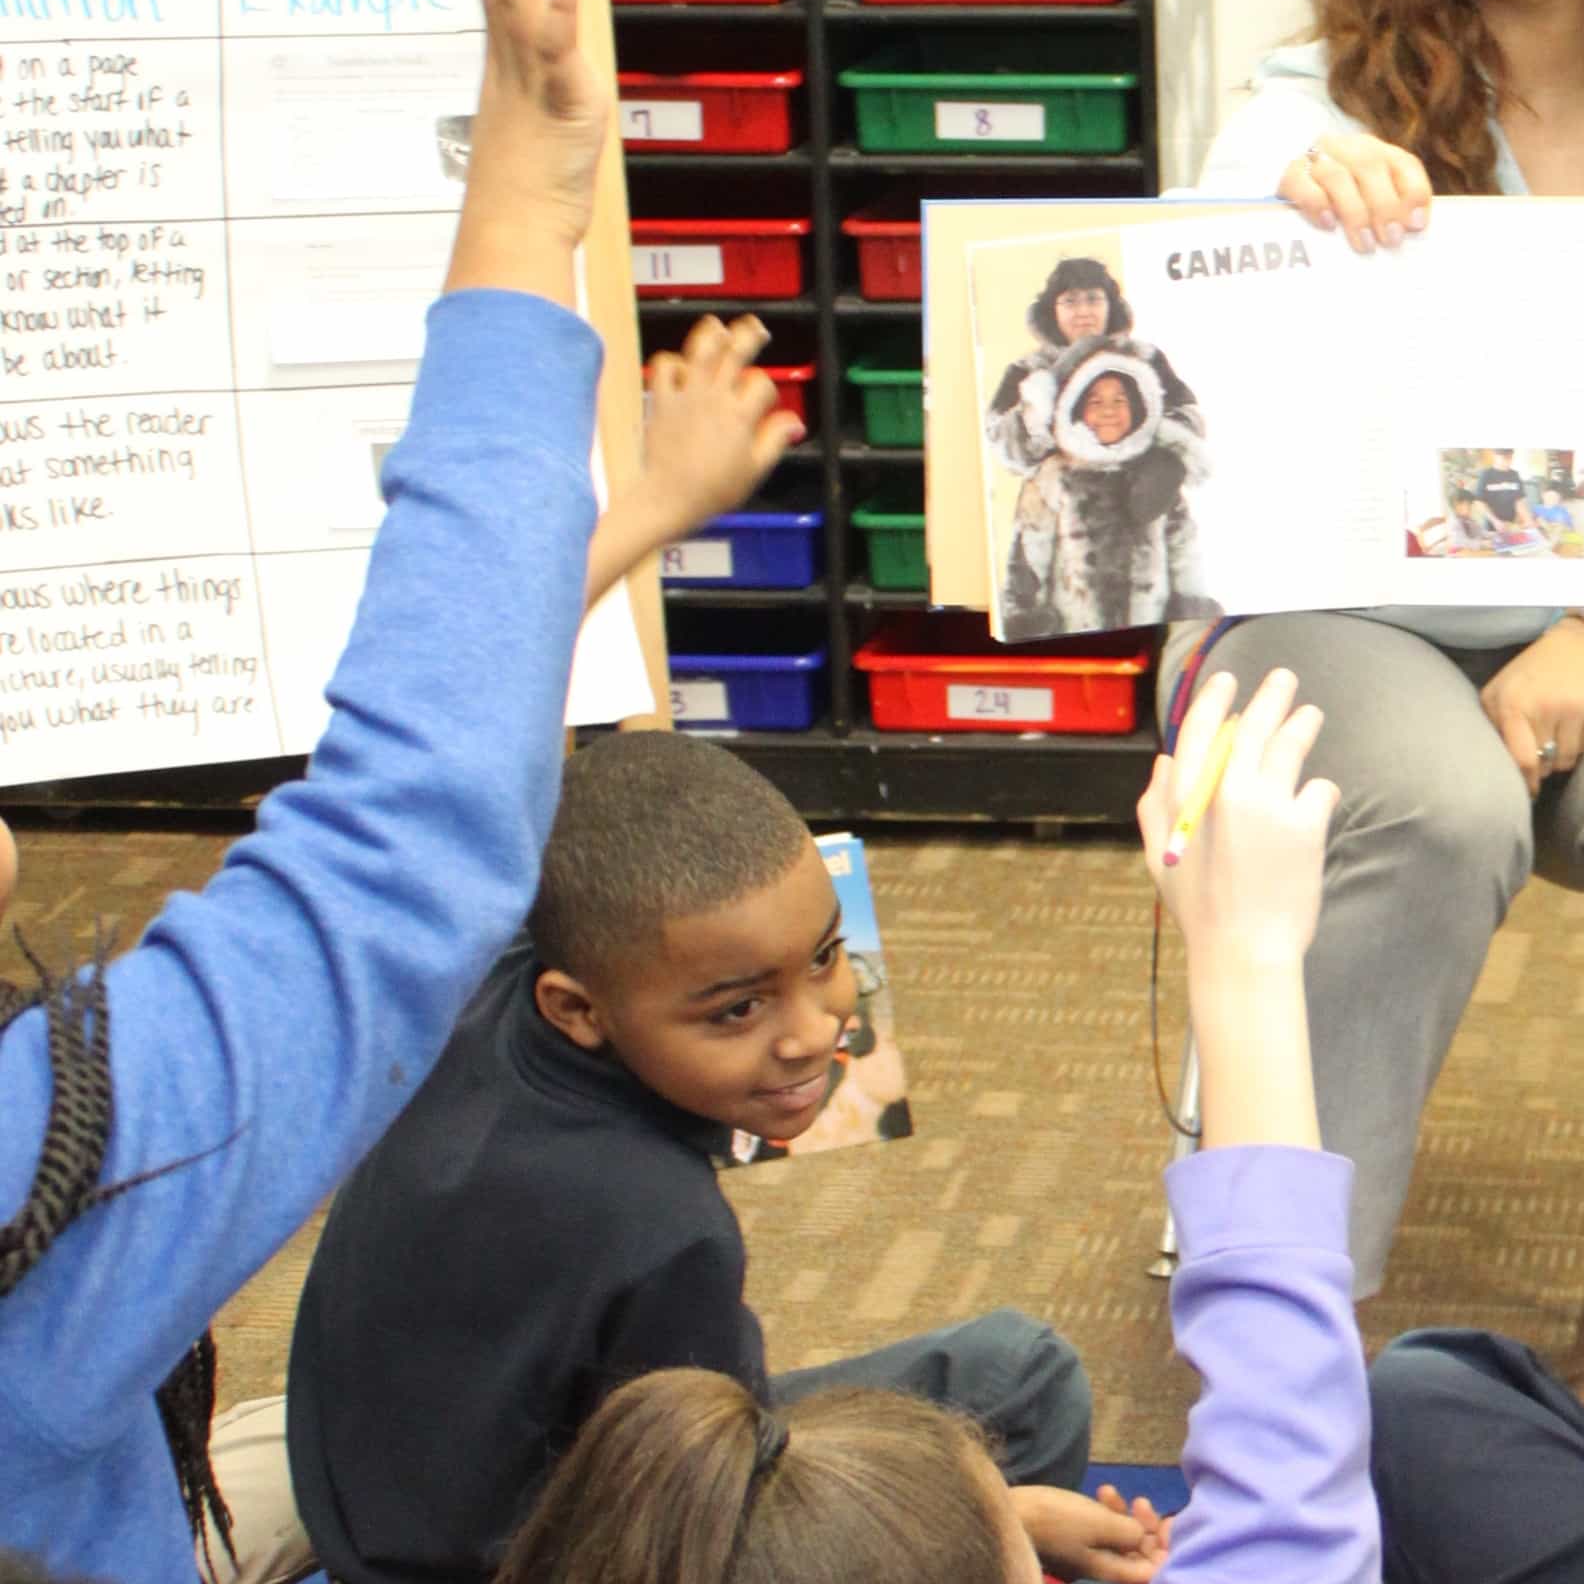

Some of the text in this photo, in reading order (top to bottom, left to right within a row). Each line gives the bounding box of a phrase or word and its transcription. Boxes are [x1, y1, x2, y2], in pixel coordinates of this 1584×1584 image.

[974, 108, 994, 137] 8
[1165, 239, 1313, 282] CANADA
[127, 407, 213, 435] reader
[45, 445, 194, 481] something
[61, 573, 150, 606] where
[974, 690, 1012, 717] 24
